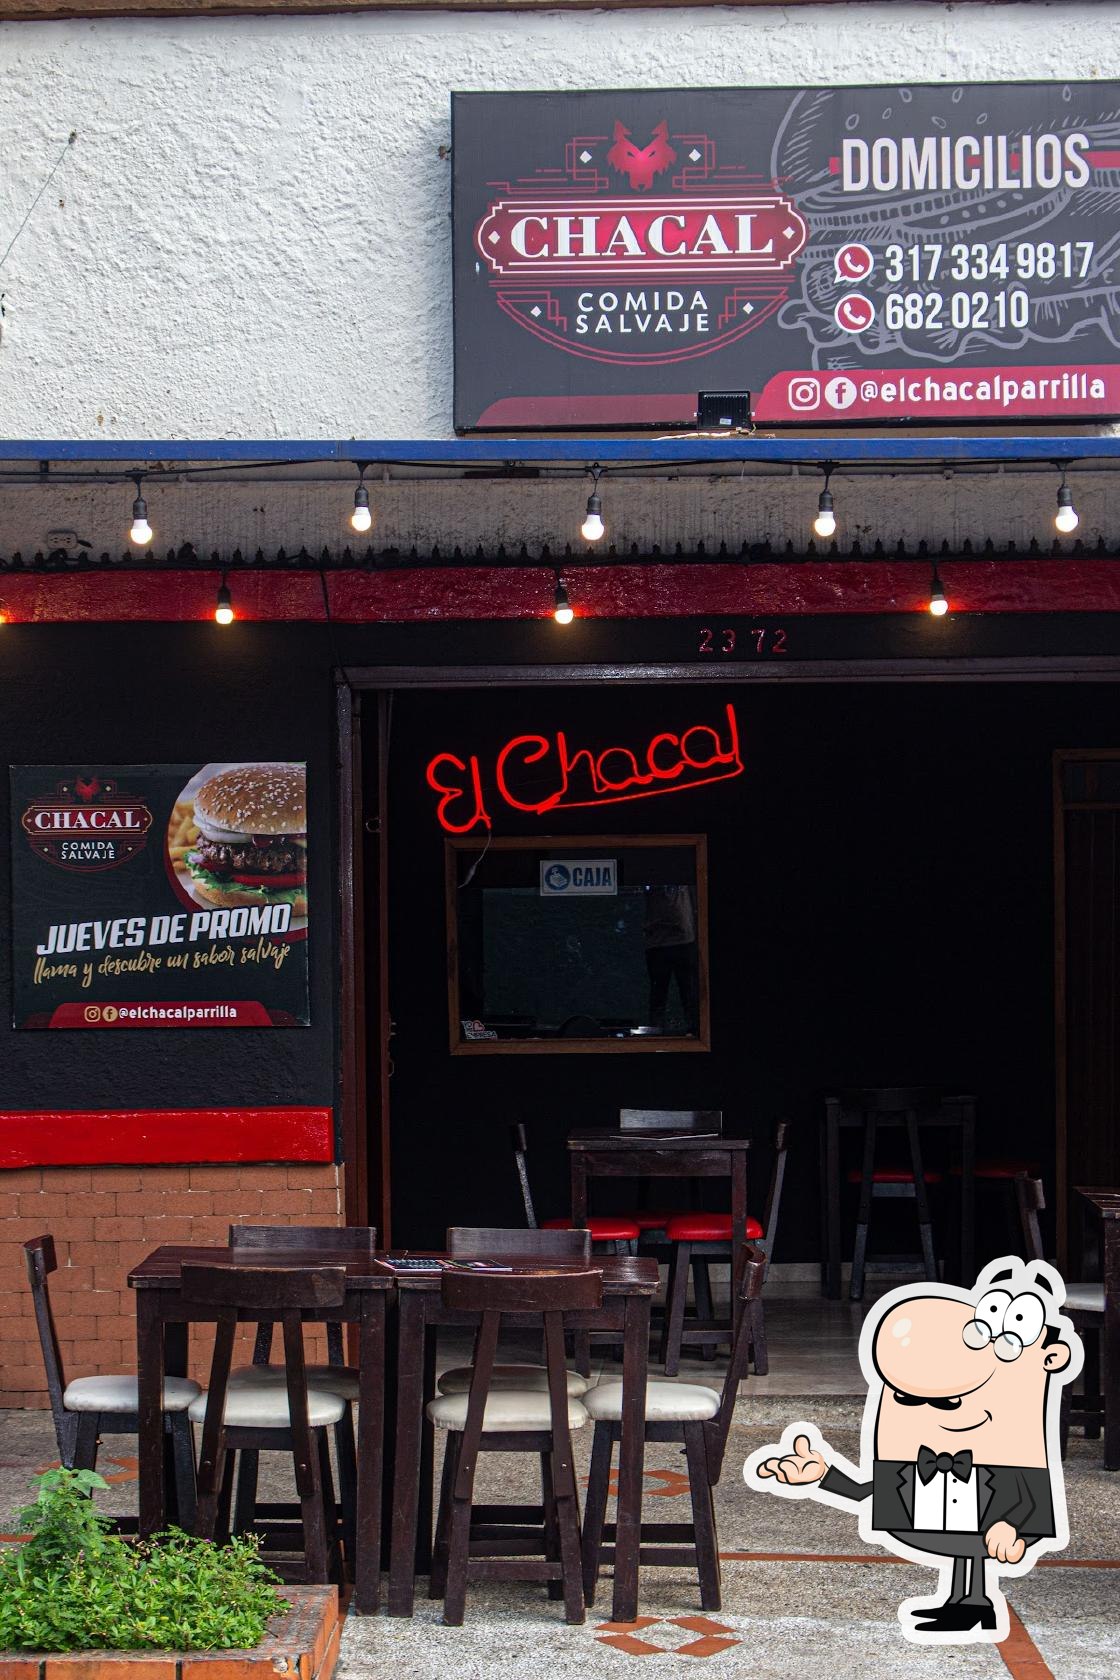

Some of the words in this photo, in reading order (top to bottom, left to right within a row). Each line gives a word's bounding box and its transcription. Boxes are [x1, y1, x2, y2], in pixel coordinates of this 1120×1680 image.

[842, 133, 1090, 192] DOMICILIOS
[510, 214, 773, 258] CHACAL
[885, 244, 942, 282] 317
[951, 243, 1009, 281] 334
[1016, 241, 1094, 279] 9817
[577, 290, 709, 312] COMIDA
[885, 292, 943, 330] 682
[951, 290, 1029, 329] 0210
[575, 313, 710, 334] SALVAJE
[860, 372, 1106, 407] @elchacalparrilla
[426, 752, 492, 834] El
[496, 703, 745, 815] Chacal
[34, 811, 140, 829] CHACAL
[61, 841, 115, 851] COMIDA
[61, 850, 116, 860] SALVAJE
[572, 867, 612, 887] CAJA
[36, 916, 147, 956] JUEVES
[148, 913, 188, 946] DE
[189, 903, 293, 942] PROMO
[33, 956, 77, 985] llama
[82, 961, 93, 988] y
[98, 950, 162, 977] descubre
[167, 951, 188, 969] un
[193, 944, 235, 968] sabor
[240, 937, 291, 969] salvaje
[118, 1005, 237, 1020] @elchacalparrilla
